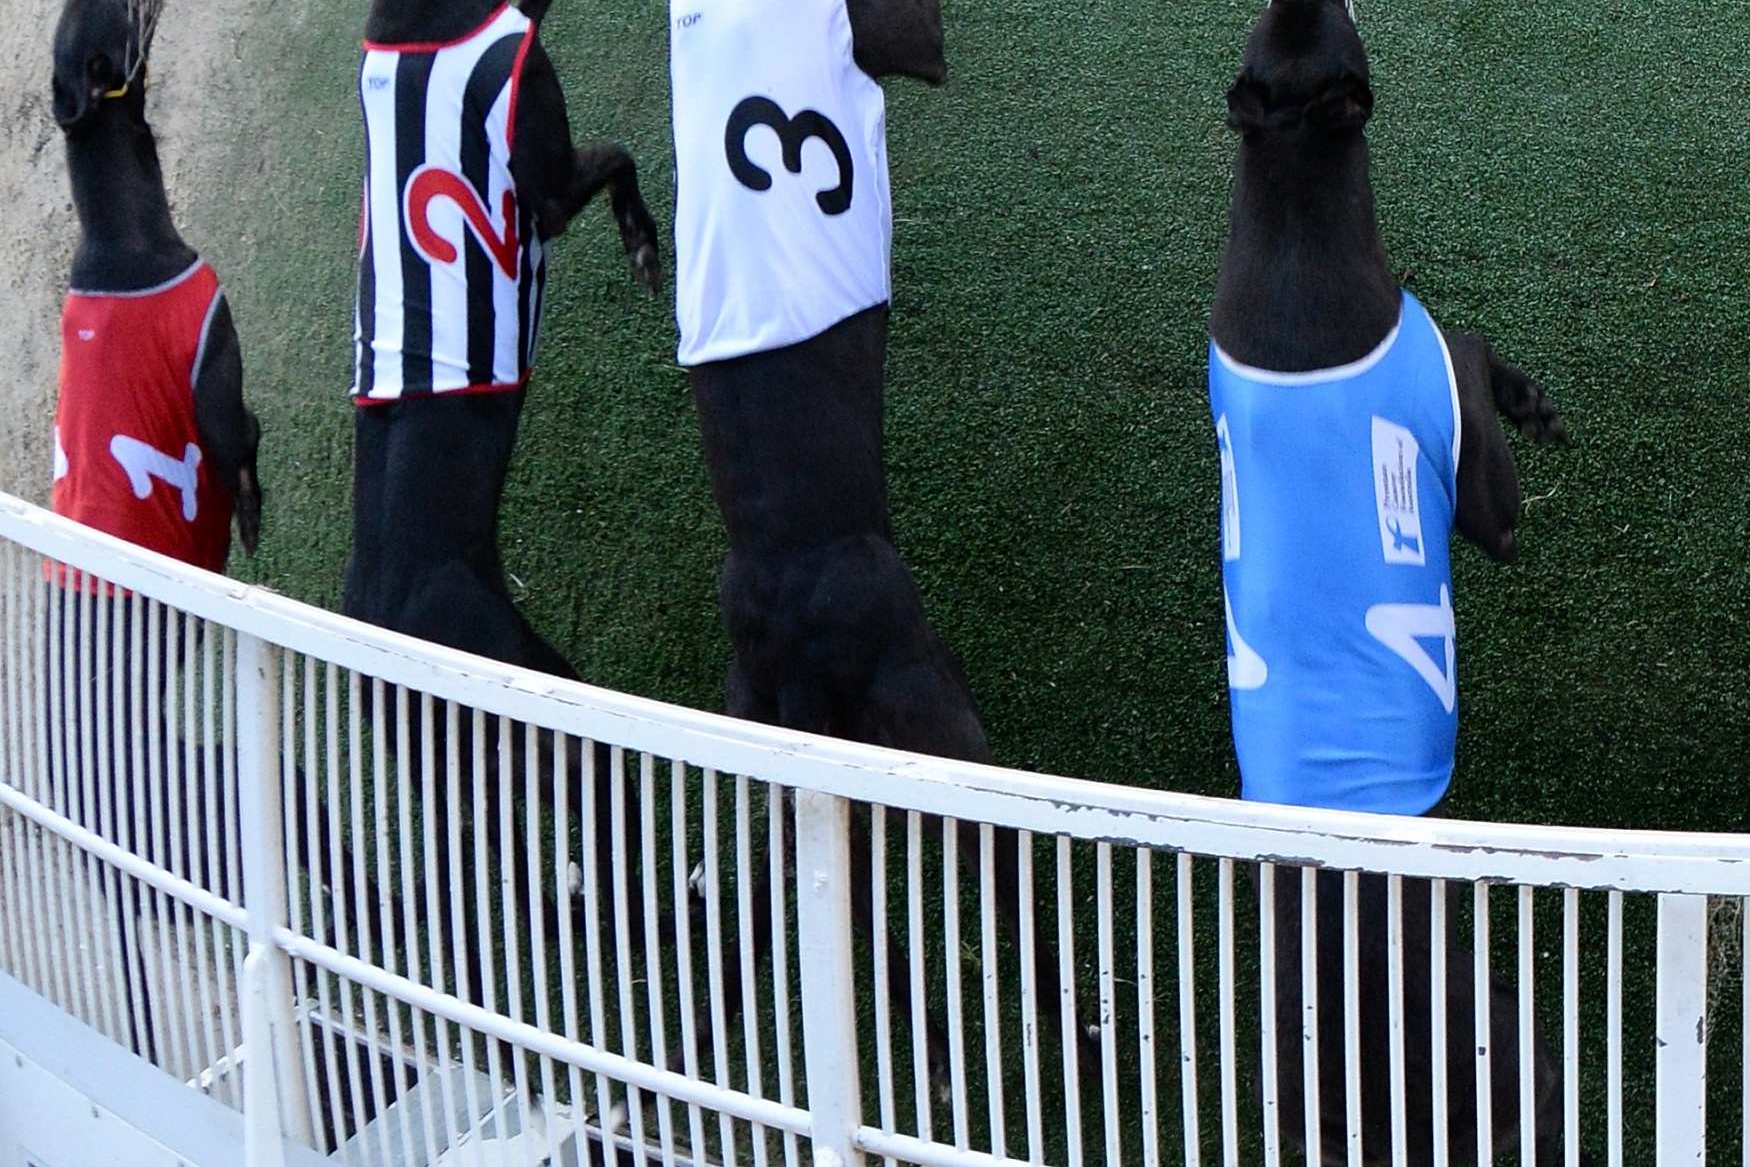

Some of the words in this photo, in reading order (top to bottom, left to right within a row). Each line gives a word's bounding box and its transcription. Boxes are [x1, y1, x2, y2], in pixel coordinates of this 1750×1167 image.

[676, 12, 702, 30] TOP
[368, 76, 390, 90] TOP
[725, 95, 854, 216] 3
[404, 165, 522, 282] 2
[110, 434, 202, 522] 1
[1365, 582, 1455, 714] 4
